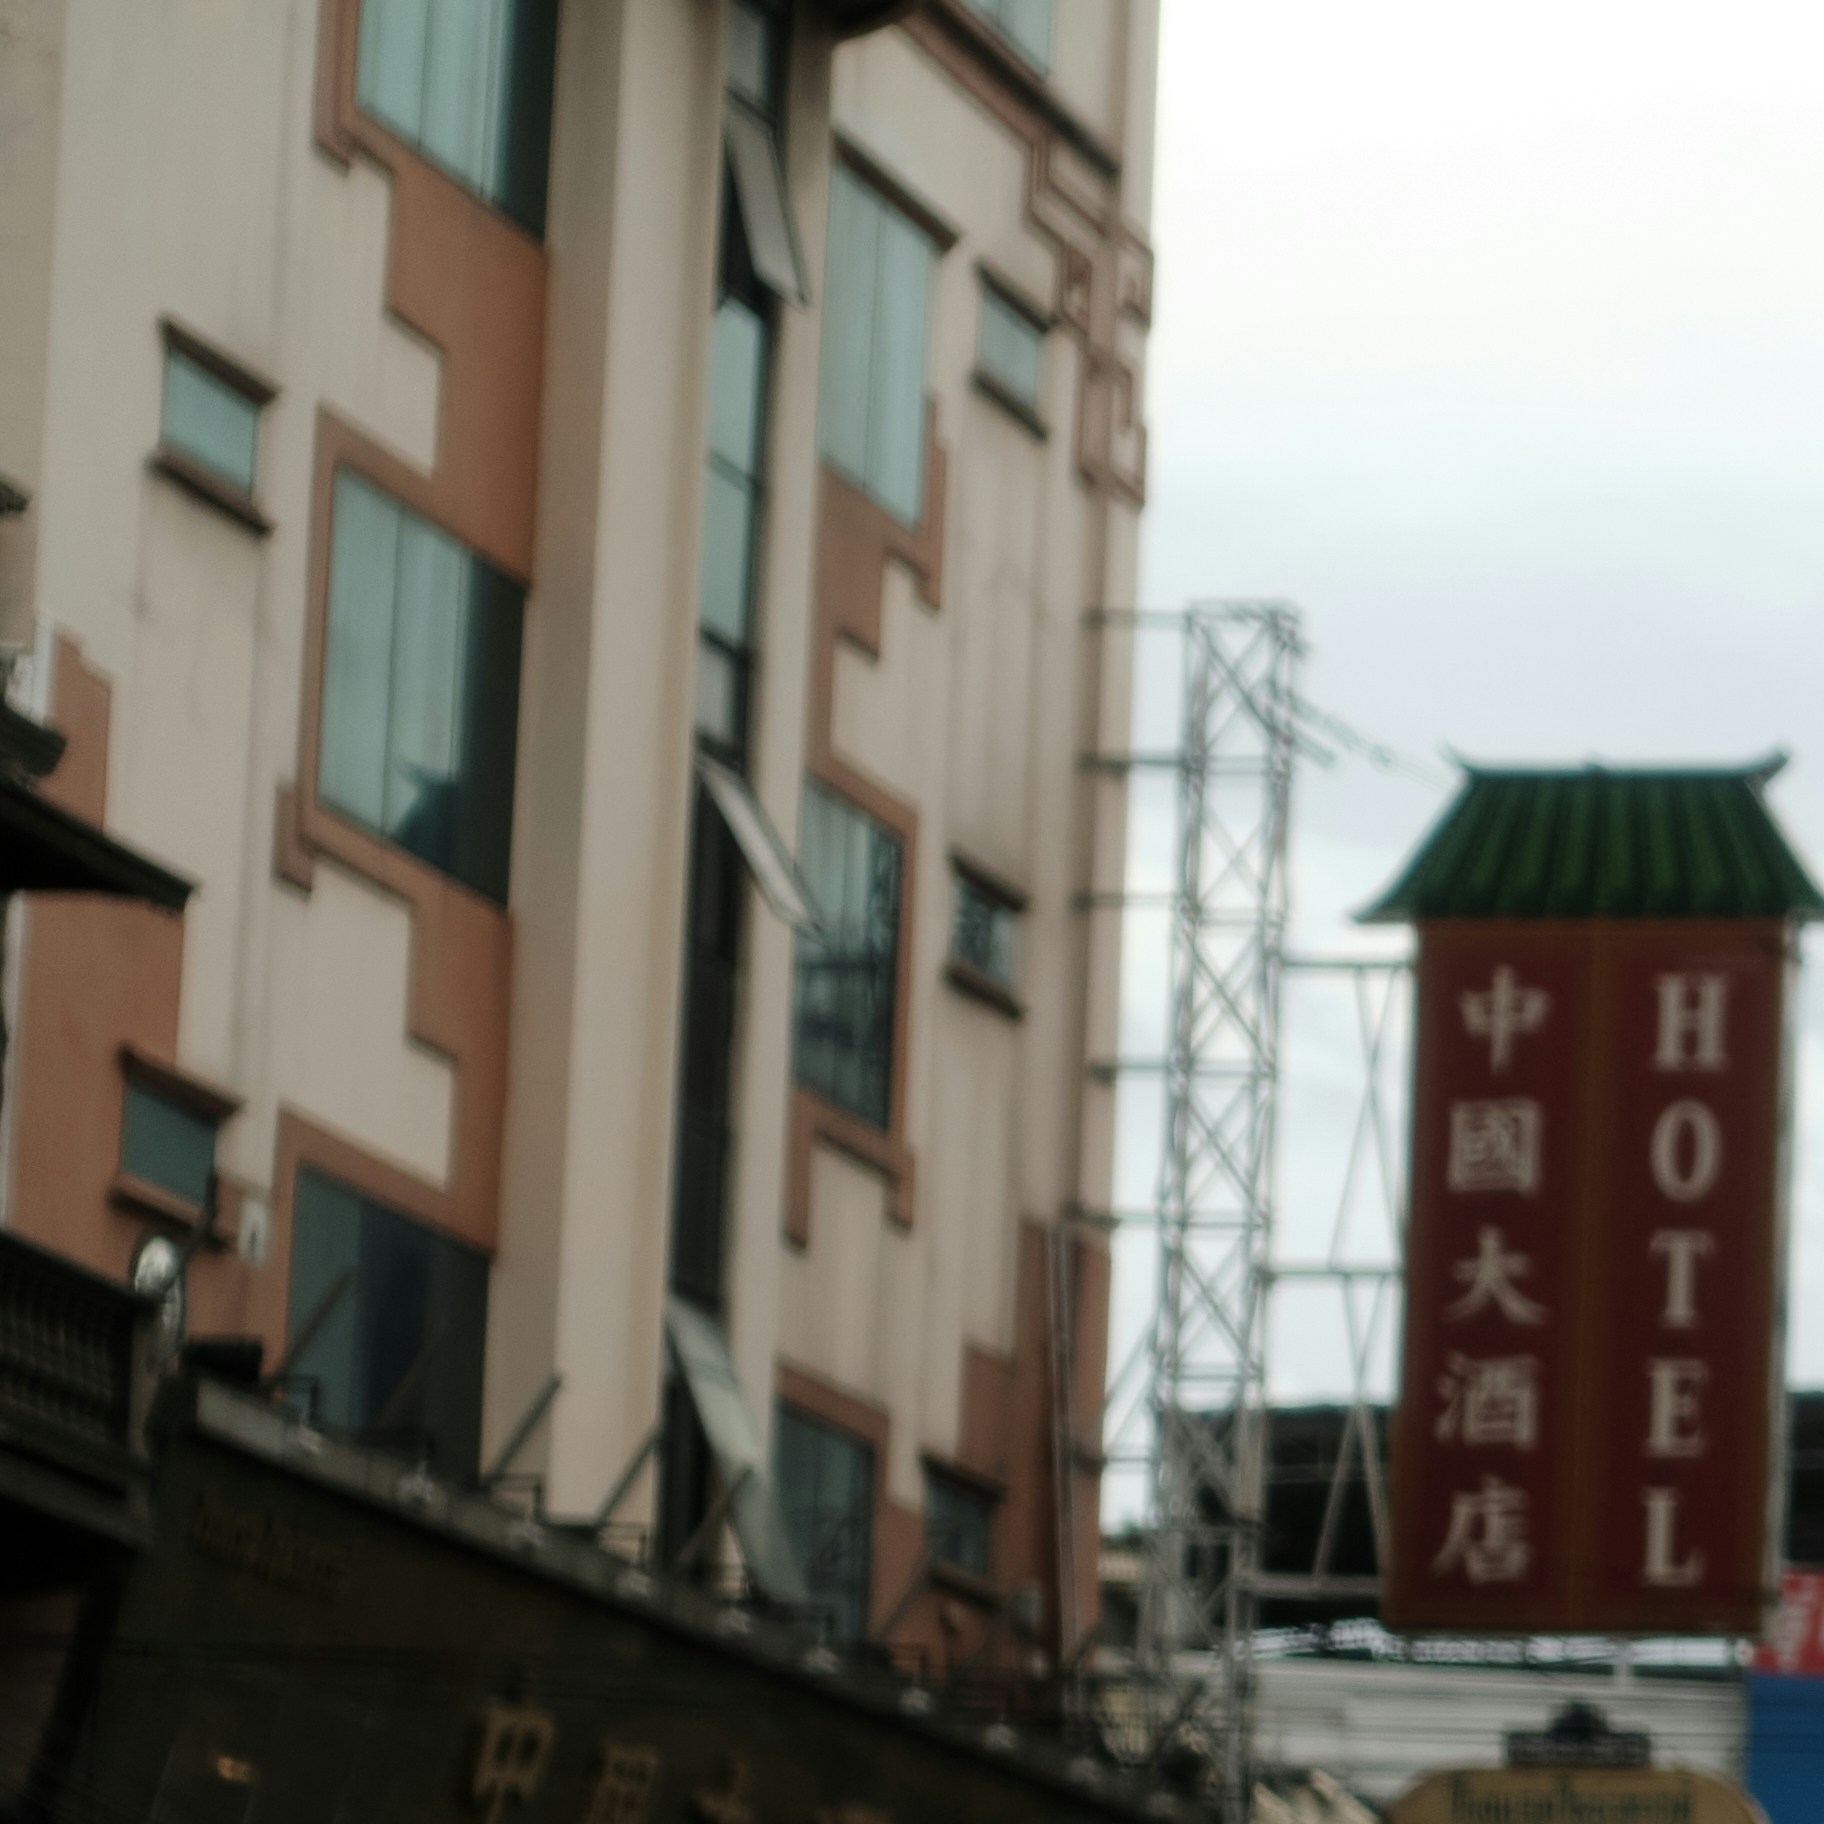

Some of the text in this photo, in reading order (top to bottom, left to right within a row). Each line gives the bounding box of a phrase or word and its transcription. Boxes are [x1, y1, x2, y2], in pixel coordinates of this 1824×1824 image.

[1433, 963, 1555, 1586] 中國大酒店
[1640, 971, 1732, 1592] HOTEL
